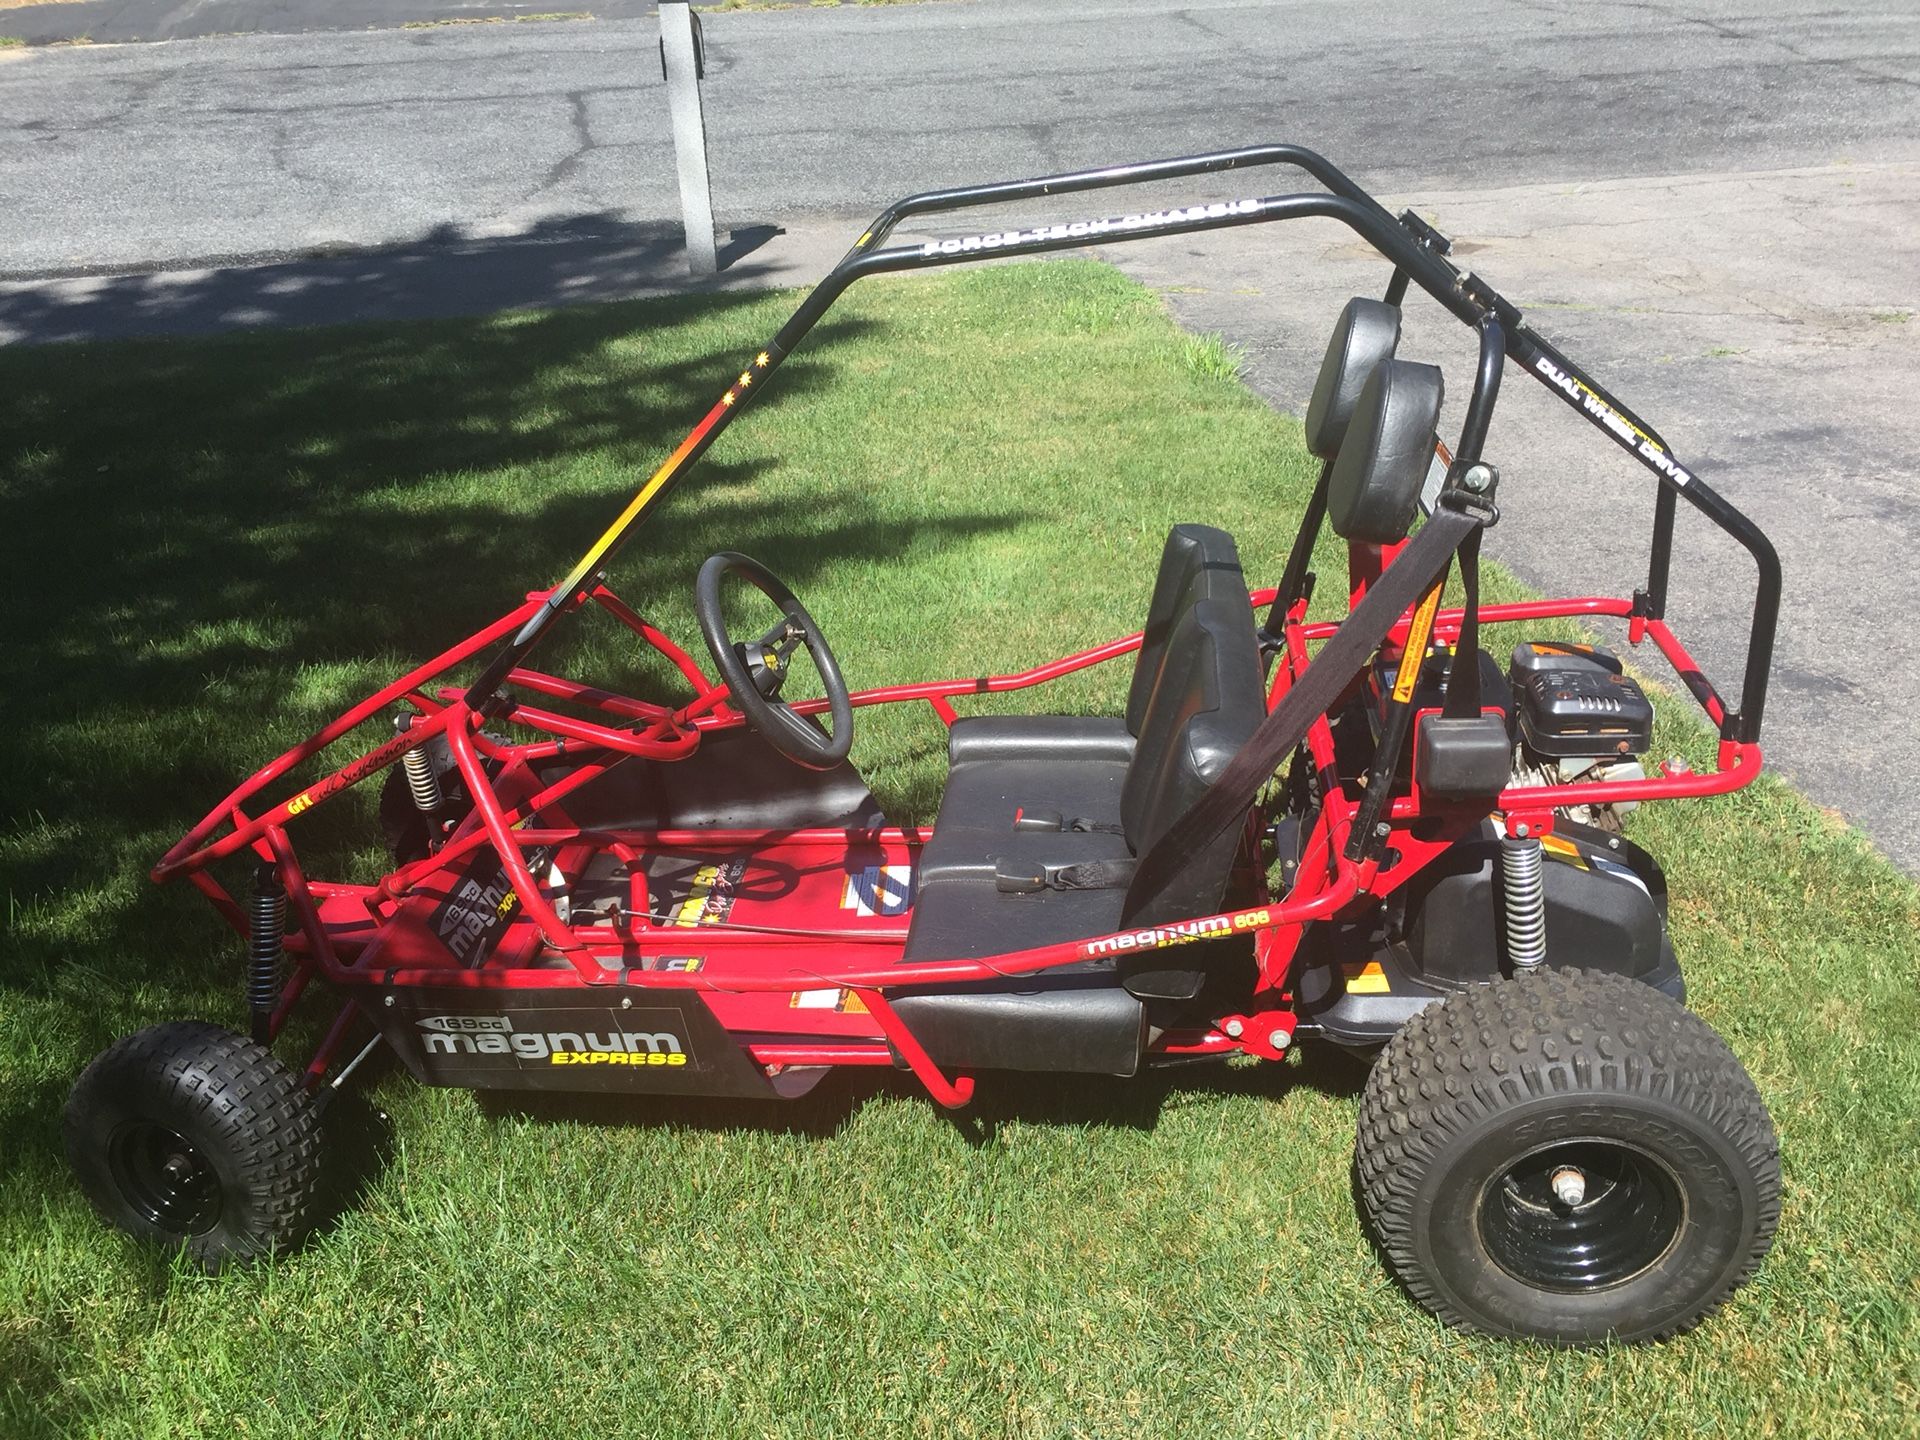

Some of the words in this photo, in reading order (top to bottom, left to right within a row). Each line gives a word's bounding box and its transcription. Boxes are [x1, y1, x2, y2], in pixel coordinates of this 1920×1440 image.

[924, 231, 1021, 256] FORCE
[1031, 218, 1109, 241] TECH
[1122, 199, 1258, 231] CHASSIS
[1536, 356, 1582, 401] DUAL
[1583, 394, 1637, 446] WHEEL
[1639, 440, 1691, 487] DRIVE
[444, 886, 478, 926] 169cc
[1087, 916, 1230, 955] magnum
[434, 1016, 505, 1030] 169cc
[421, 1032, 682, 1059] magnum
[551, 1052, 687, 1066] EXPRESS
